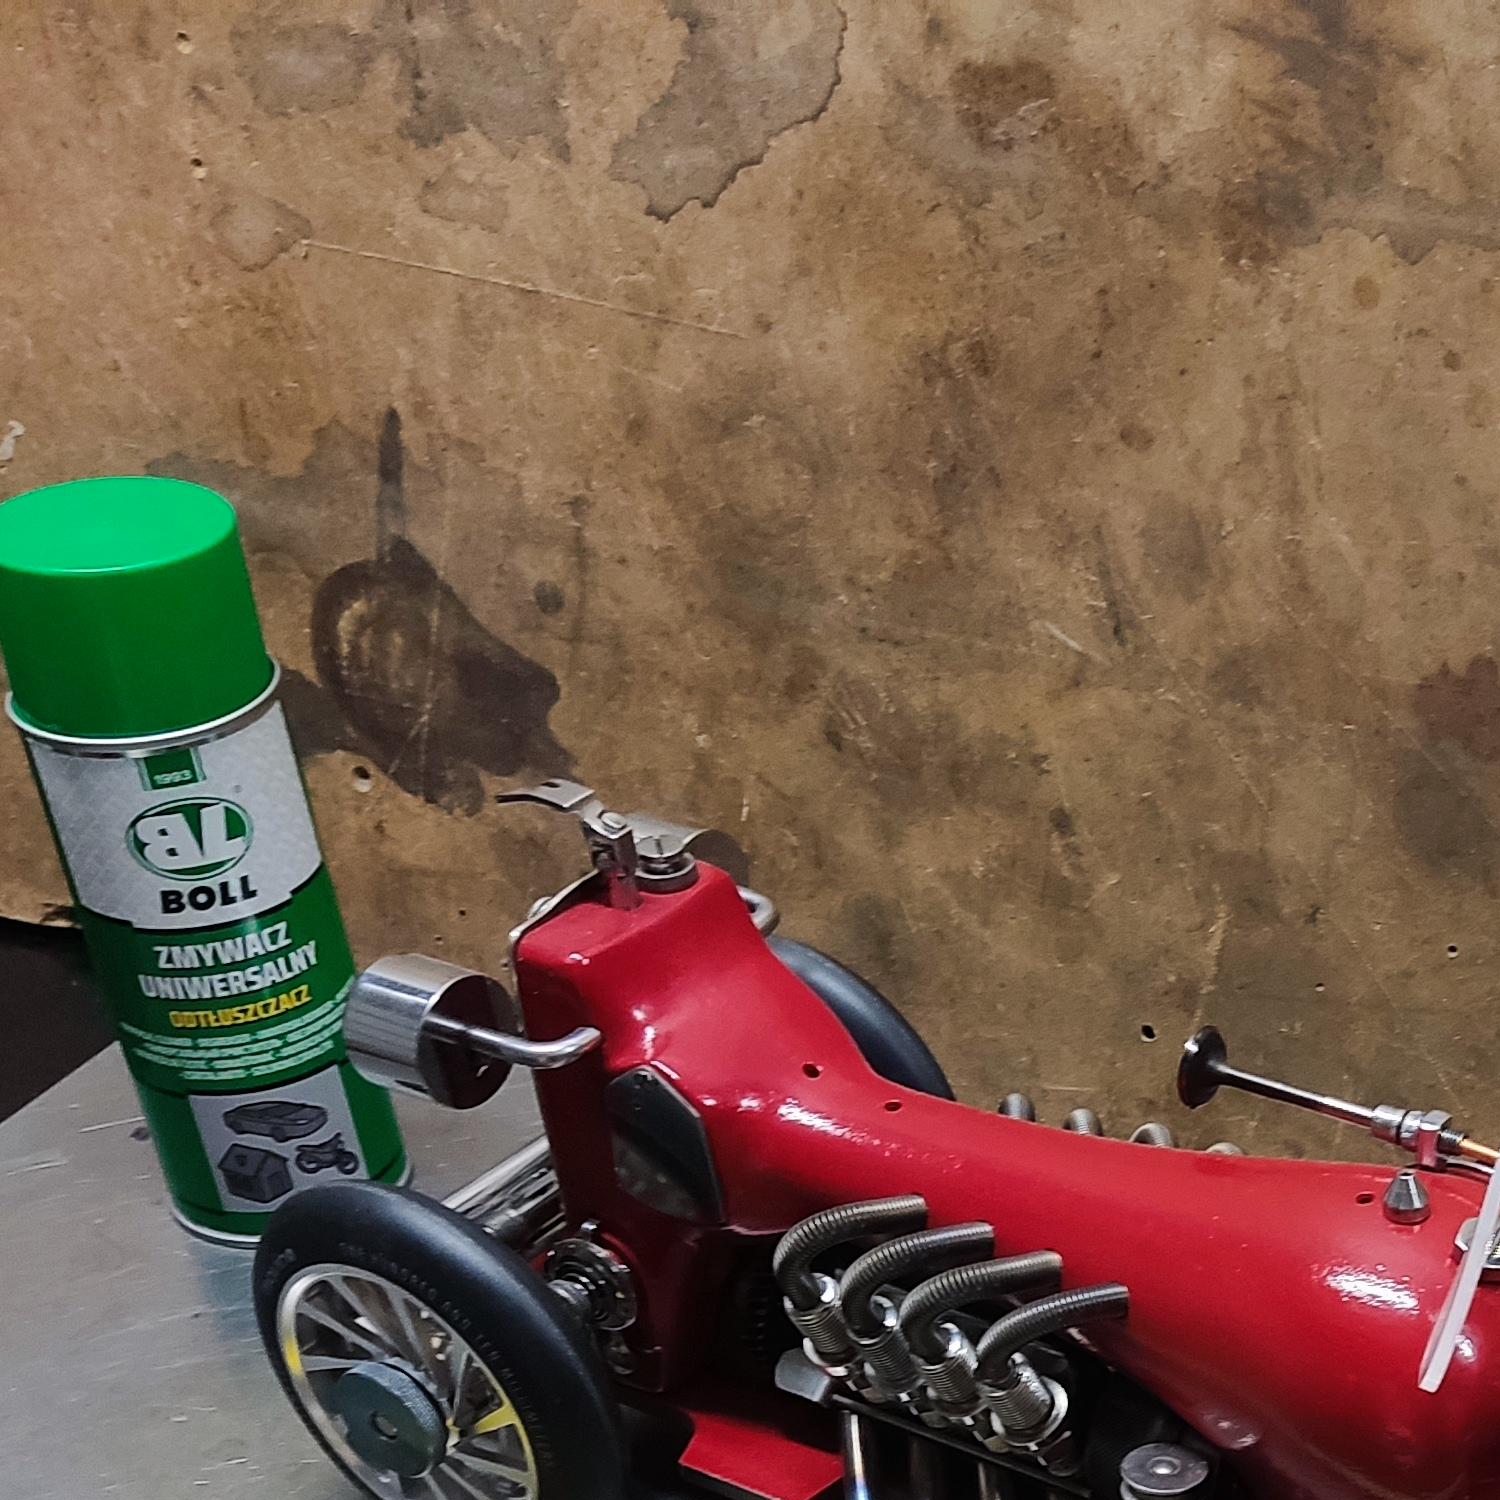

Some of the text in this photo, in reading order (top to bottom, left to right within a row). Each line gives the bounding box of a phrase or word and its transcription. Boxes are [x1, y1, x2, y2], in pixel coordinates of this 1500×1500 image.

[153, 769, 193, 785] 1993
[159, 875, 258, 914] BOLL
[152, 921, 293, 969] ZMYWACZ
[137, 940, 318, 1000] UNIWERSALNY
